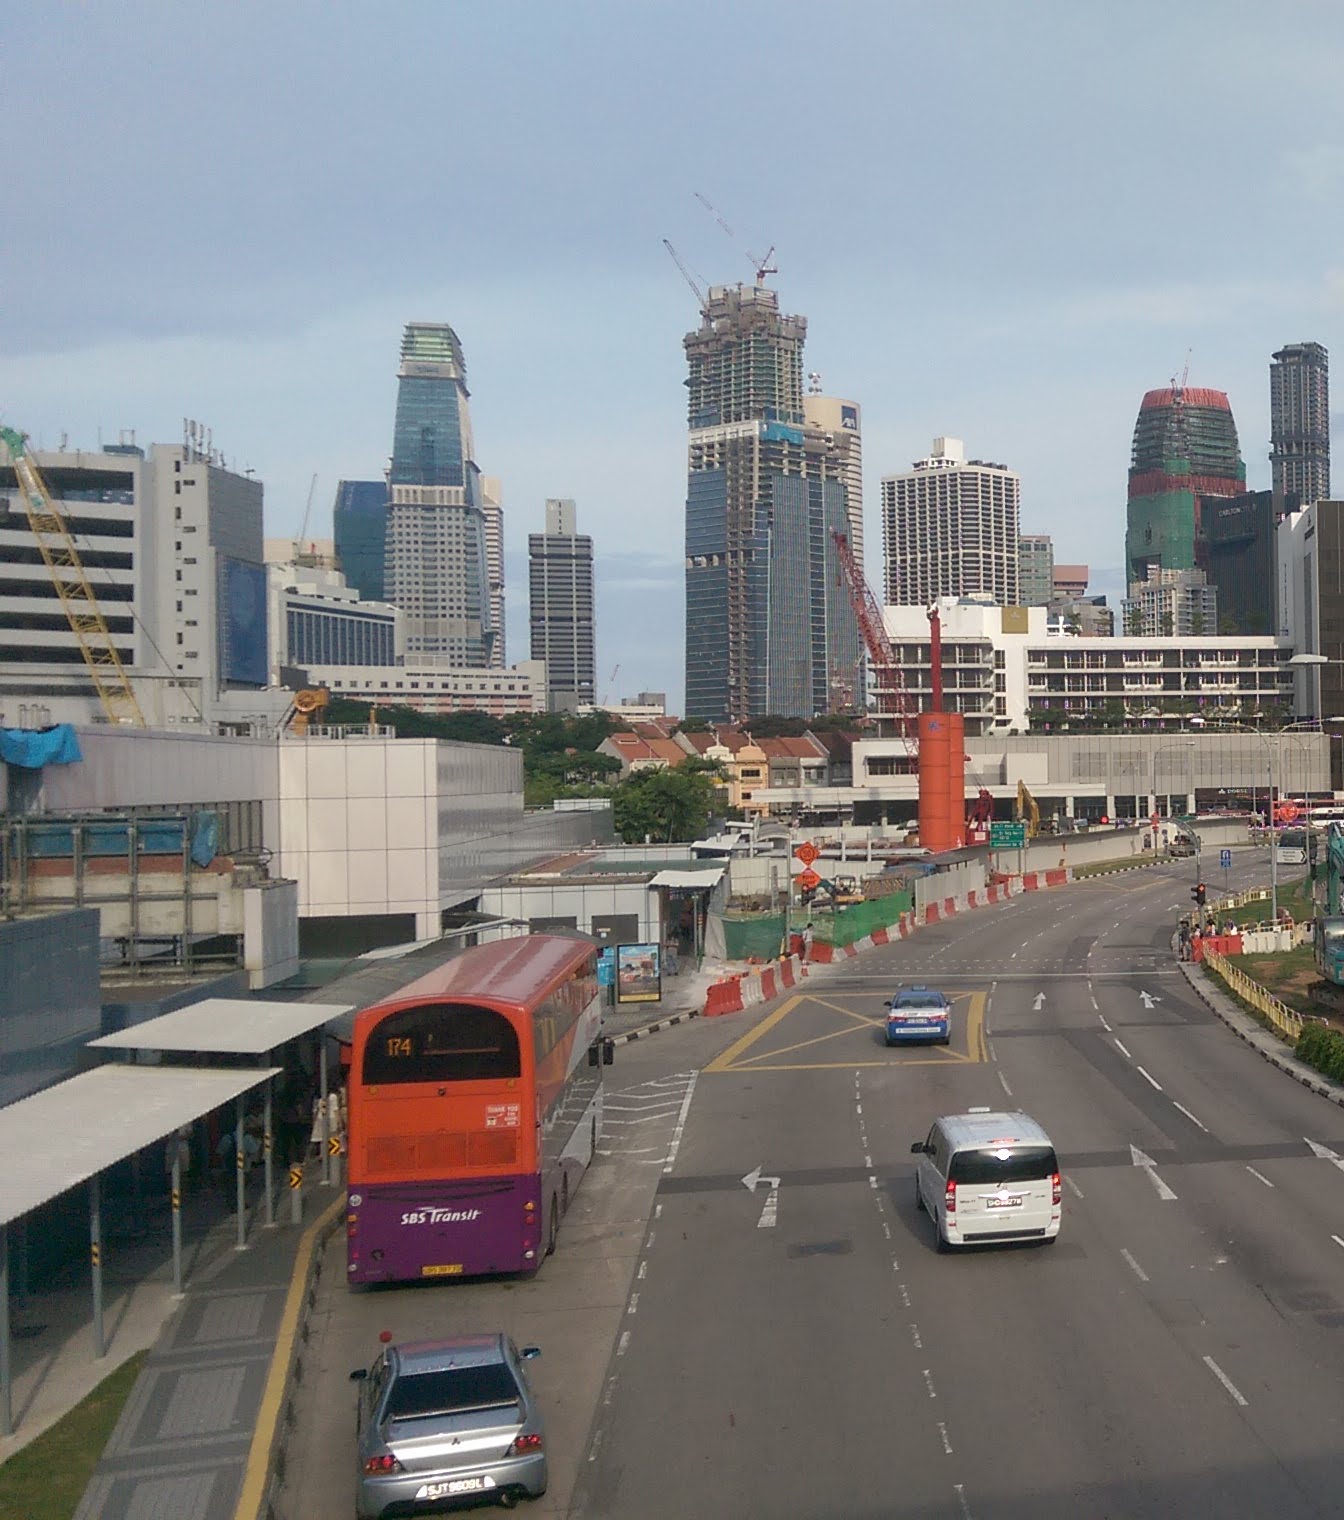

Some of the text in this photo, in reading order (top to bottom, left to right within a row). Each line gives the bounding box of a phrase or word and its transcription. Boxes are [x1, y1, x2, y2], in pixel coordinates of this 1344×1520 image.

[388, 1038, 411, 1056] 174
[401, 1206, 482, 1225] SBS Transit
